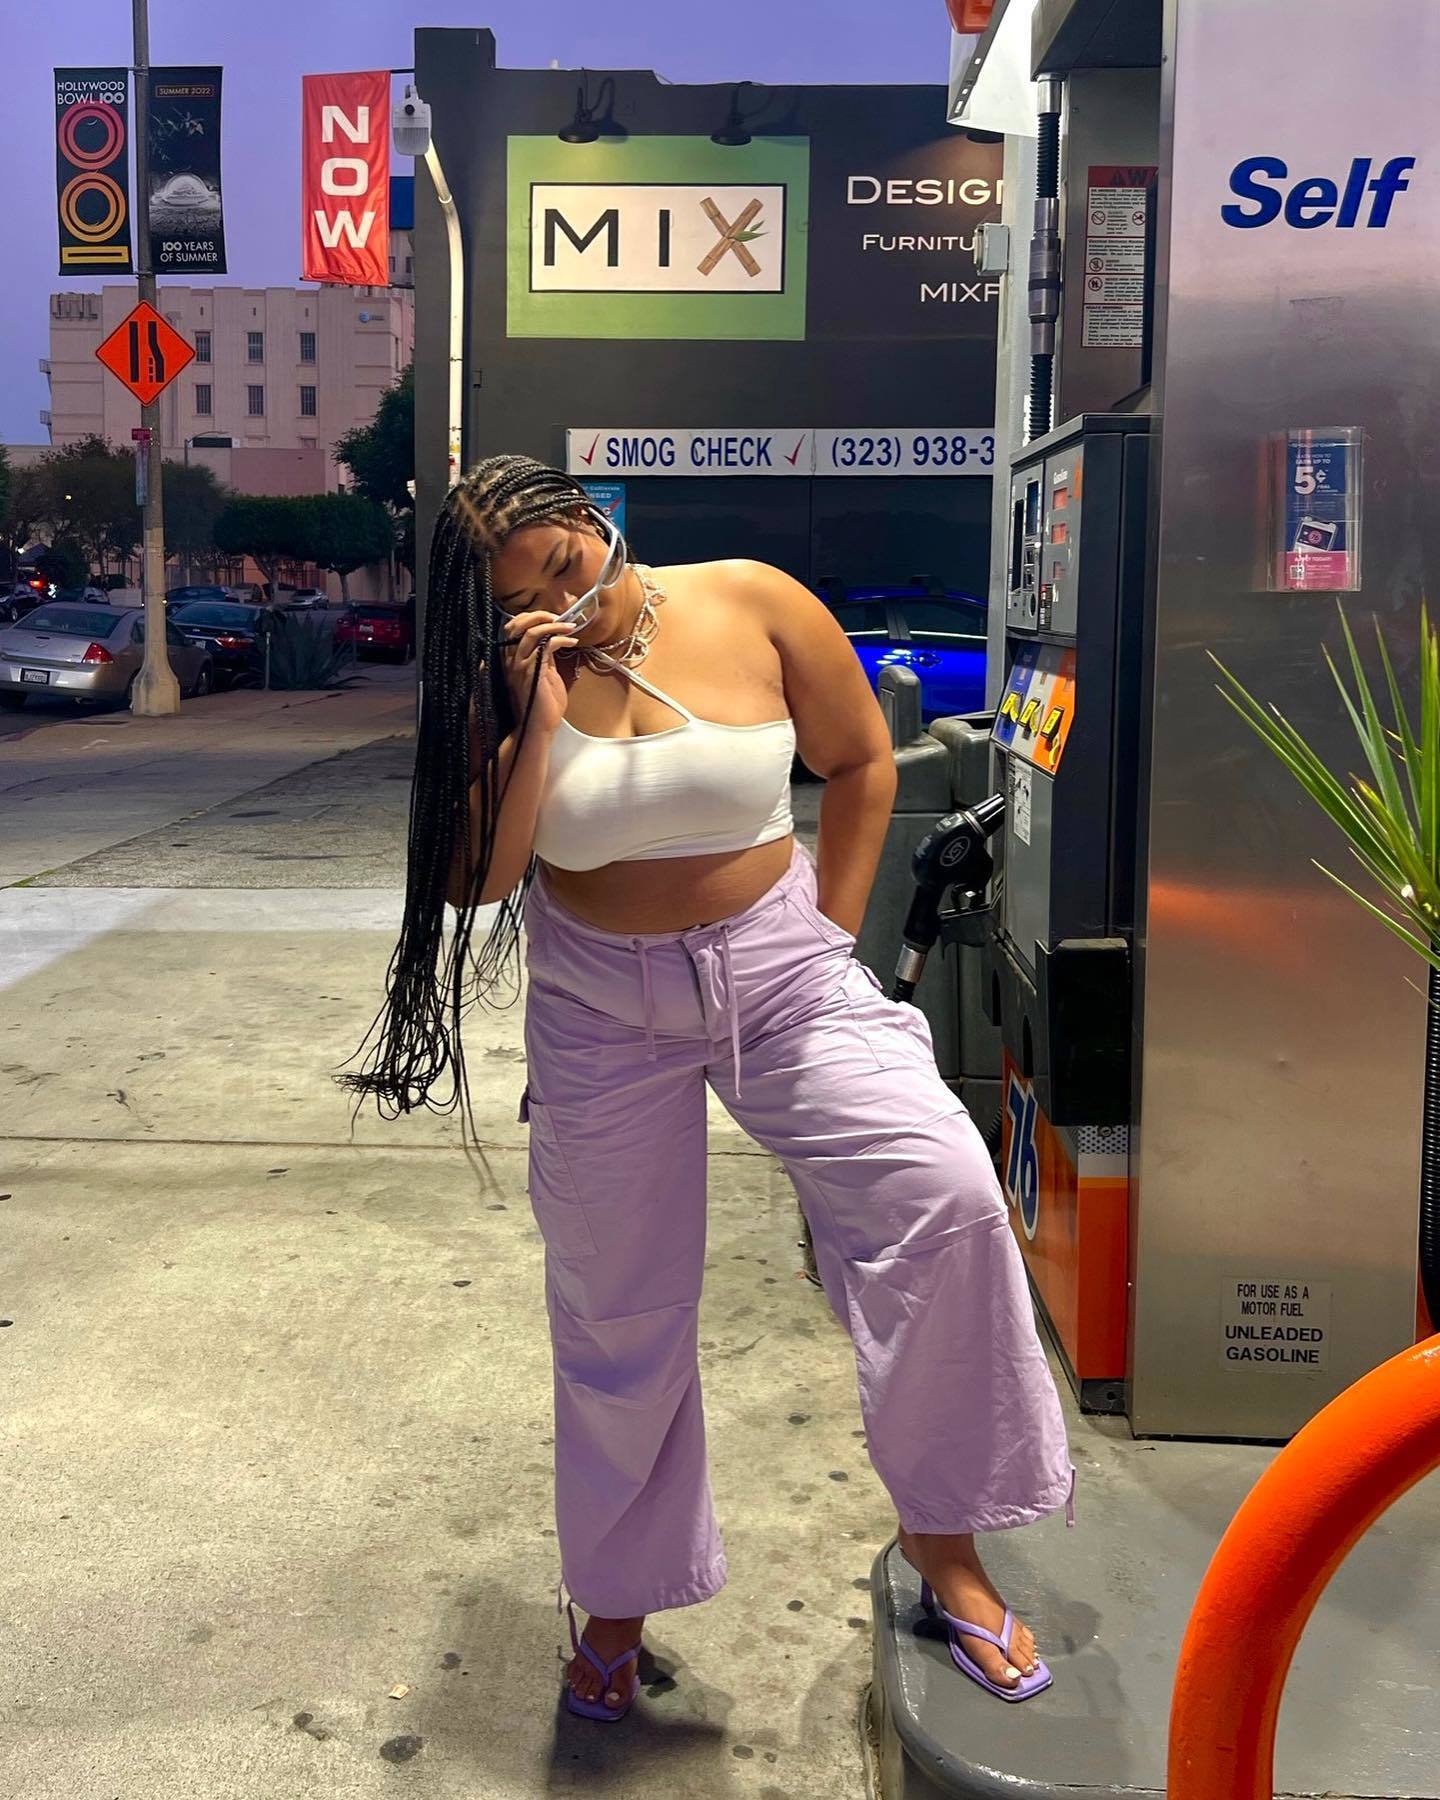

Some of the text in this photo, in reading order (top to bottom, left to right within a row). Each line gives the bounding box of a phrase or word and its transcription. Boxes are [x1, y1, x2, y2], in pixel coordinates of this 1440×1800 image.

[57, 81, 125, 91] HOLLYWOOD
[159, 88, 190, 96] SUMMER
[57, 92, 125, 105] BOWL 100
[314, 105, 376, 249] NOW
[847, 176, 1003, 206] DESIG
[1221, 156, 1416, 229] Self
[544, 197, 765, 278] MIX
[162, 241, 215, 252] 100 YEARS
[160, 252, 218, 263] OF SUMMER
[606, 437, 675, 467] SMOG
[690, 437, 772, 467] CHECK
[832, 437, 901, 467] (323)
[1005, 1068, 1039, 1241] 76
[1237, 1284, 1309, 1299] FOR USE AS A
[1241, 1301, 1304, 1316] MOTOR FUEL
[1225, 1325, 1323, 1342] UNLEADED
[1226, 1346, 1320, 1363] GASOLINE
